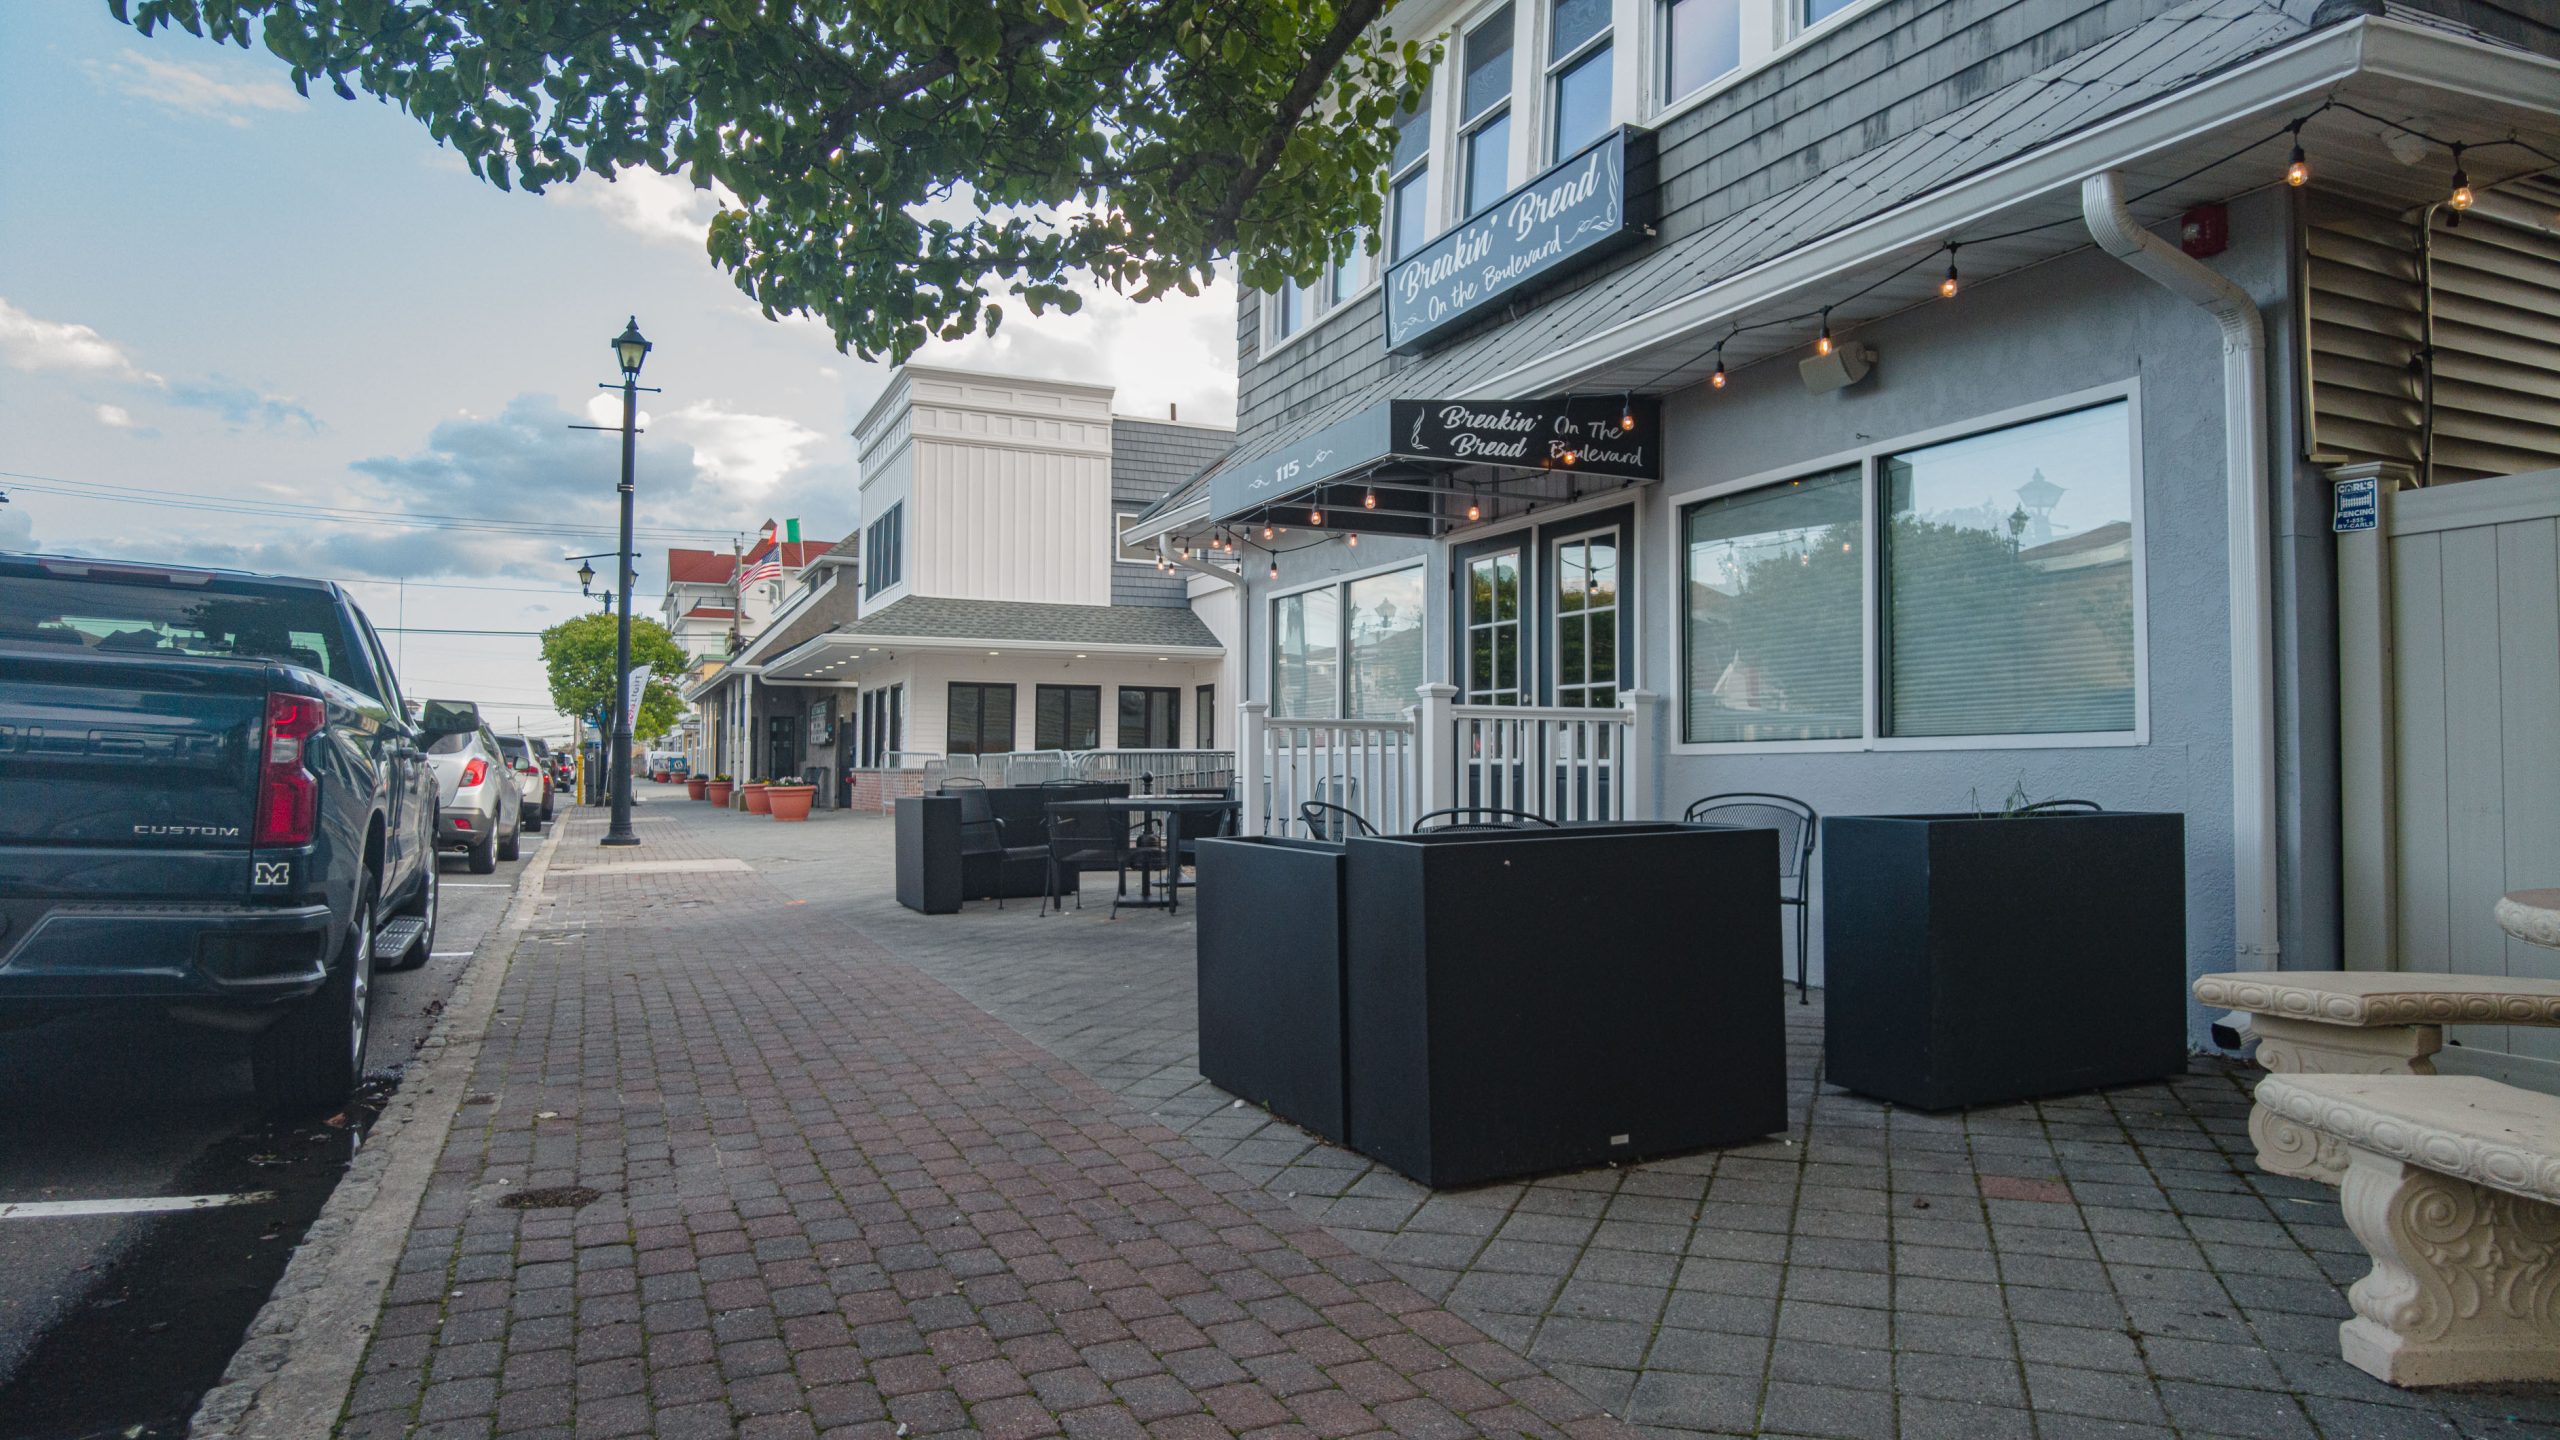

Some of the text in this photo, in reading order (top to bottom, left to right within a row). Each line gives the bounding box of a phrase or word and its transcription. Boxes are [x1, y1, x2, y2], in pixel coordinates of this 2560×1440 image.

[1400, 153, 1601, 305] Breakin' Bread
[1428, 226, 1563, 322] On the Boulevard
[1439, 405, 1543, 433] Breakin'
[1554, 415, 1624, 440] On The
[1450, 433, 1528, 458] Bread
[1276, 458, 1300, 483] 115
[2337, 507, 2374, 518] FENCING
[2337, 521, 2374, 529] BY-CARLS
[133, 825, 240, 836] CUSTOM
[254, 862, 290, 885] M
